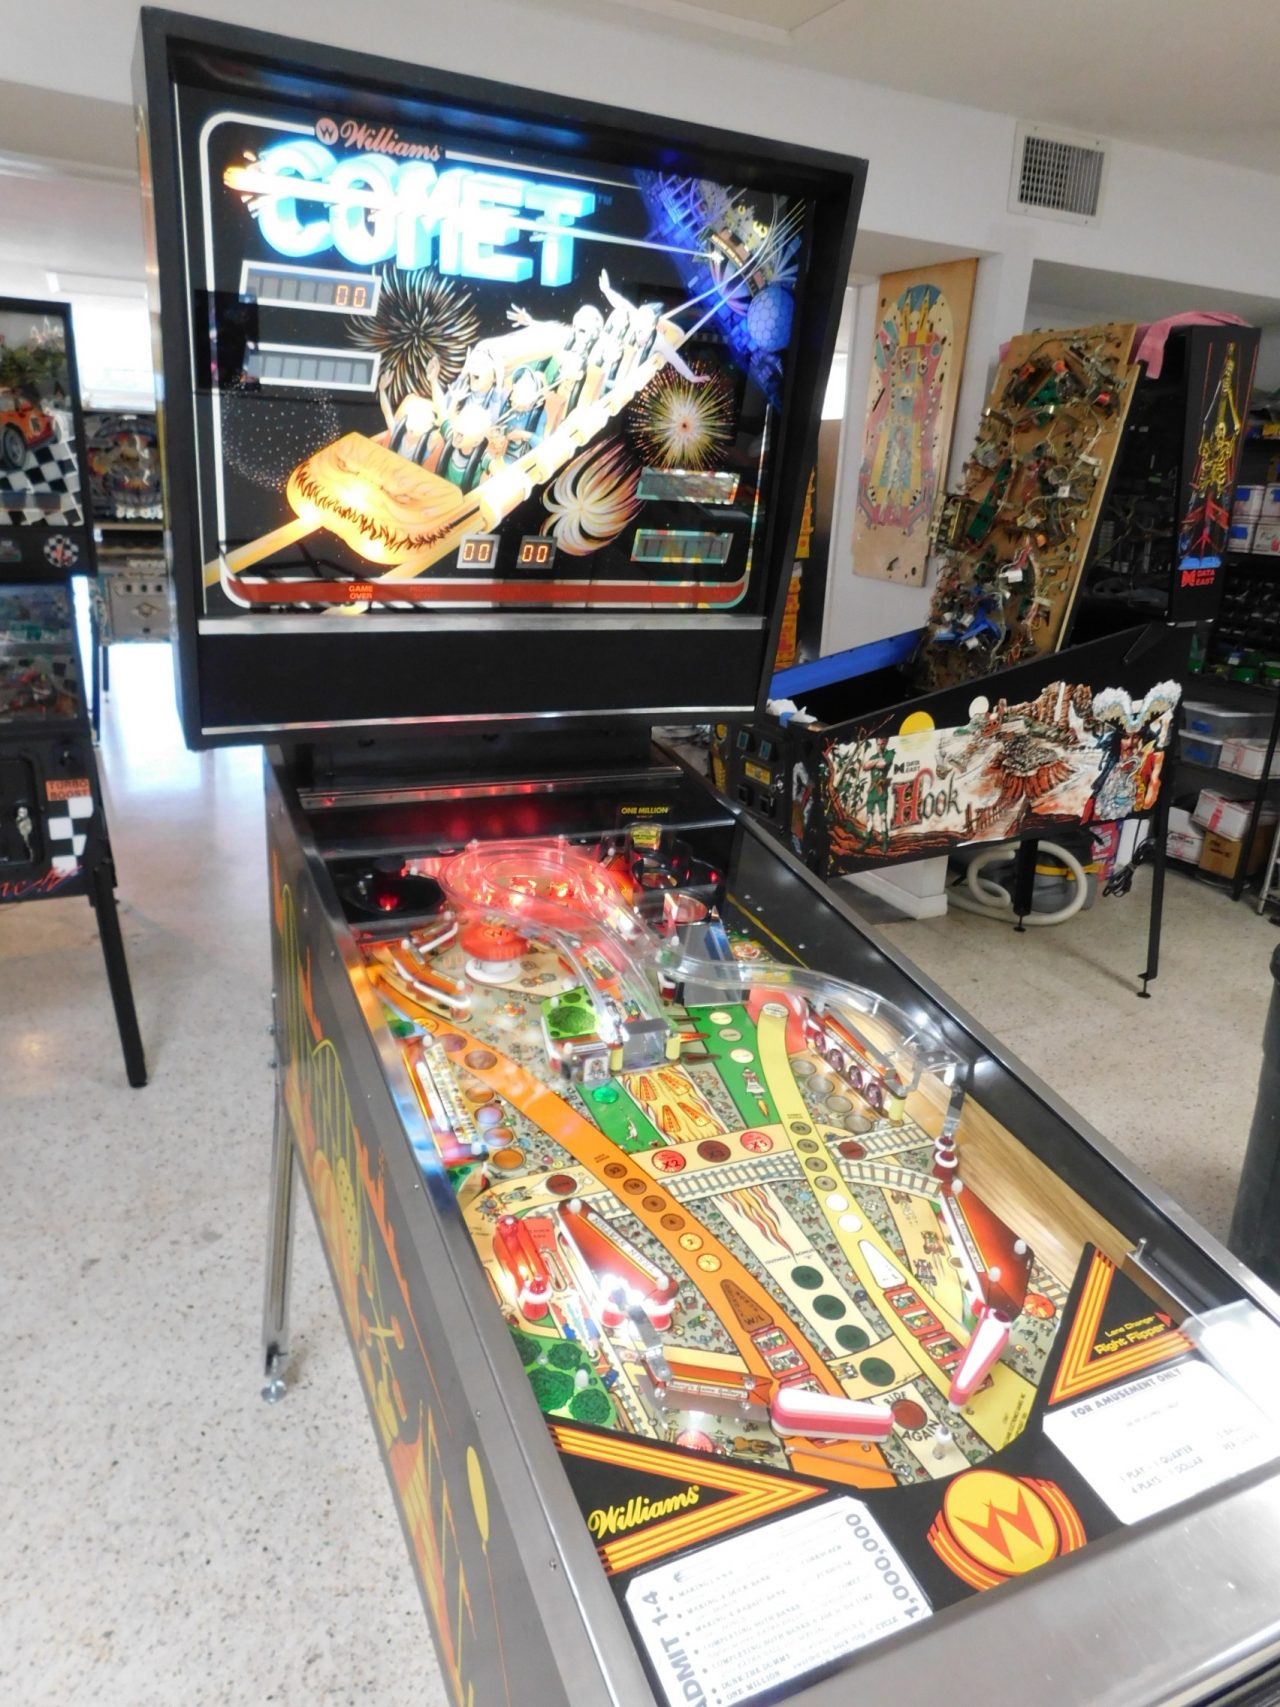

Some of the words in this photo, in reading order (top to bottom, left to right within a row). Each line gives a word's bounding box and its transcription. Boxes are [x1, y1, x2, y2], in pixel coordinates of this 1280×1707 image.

[340, 120, 441, 161] Williams
[257, 140, 595, 287] COMET
[463, 543, 490, 561] 00
[521, 544, 548, 563] 00
[1195, 577, 1215, 586] EAST
[1197, 569, 1215, 577] DATA
[50, 780, 88, 791] TURBO
[50, 790, 88, 799] BOOST
[891, 768, 963, 829] Hook
[638, 806, 669, 814] MILLION
[1094, 1337, 1128, 1355] Right
[1127, 1323, 1166, 1344] Flipper
[884, 1391, 908, 1404] RIDE
[1071, 1404, 1093, 1417] FOR
[1095, 1378, 1155, 1407] AMUSEMENT
[1156, 1367, 1181, 1381] ONLY
[902, 1419, 941, 1442] AGAIN
[587, 1485, 699, 1539] Williams
[845, 1513, 920, 1620] 1,000,000
